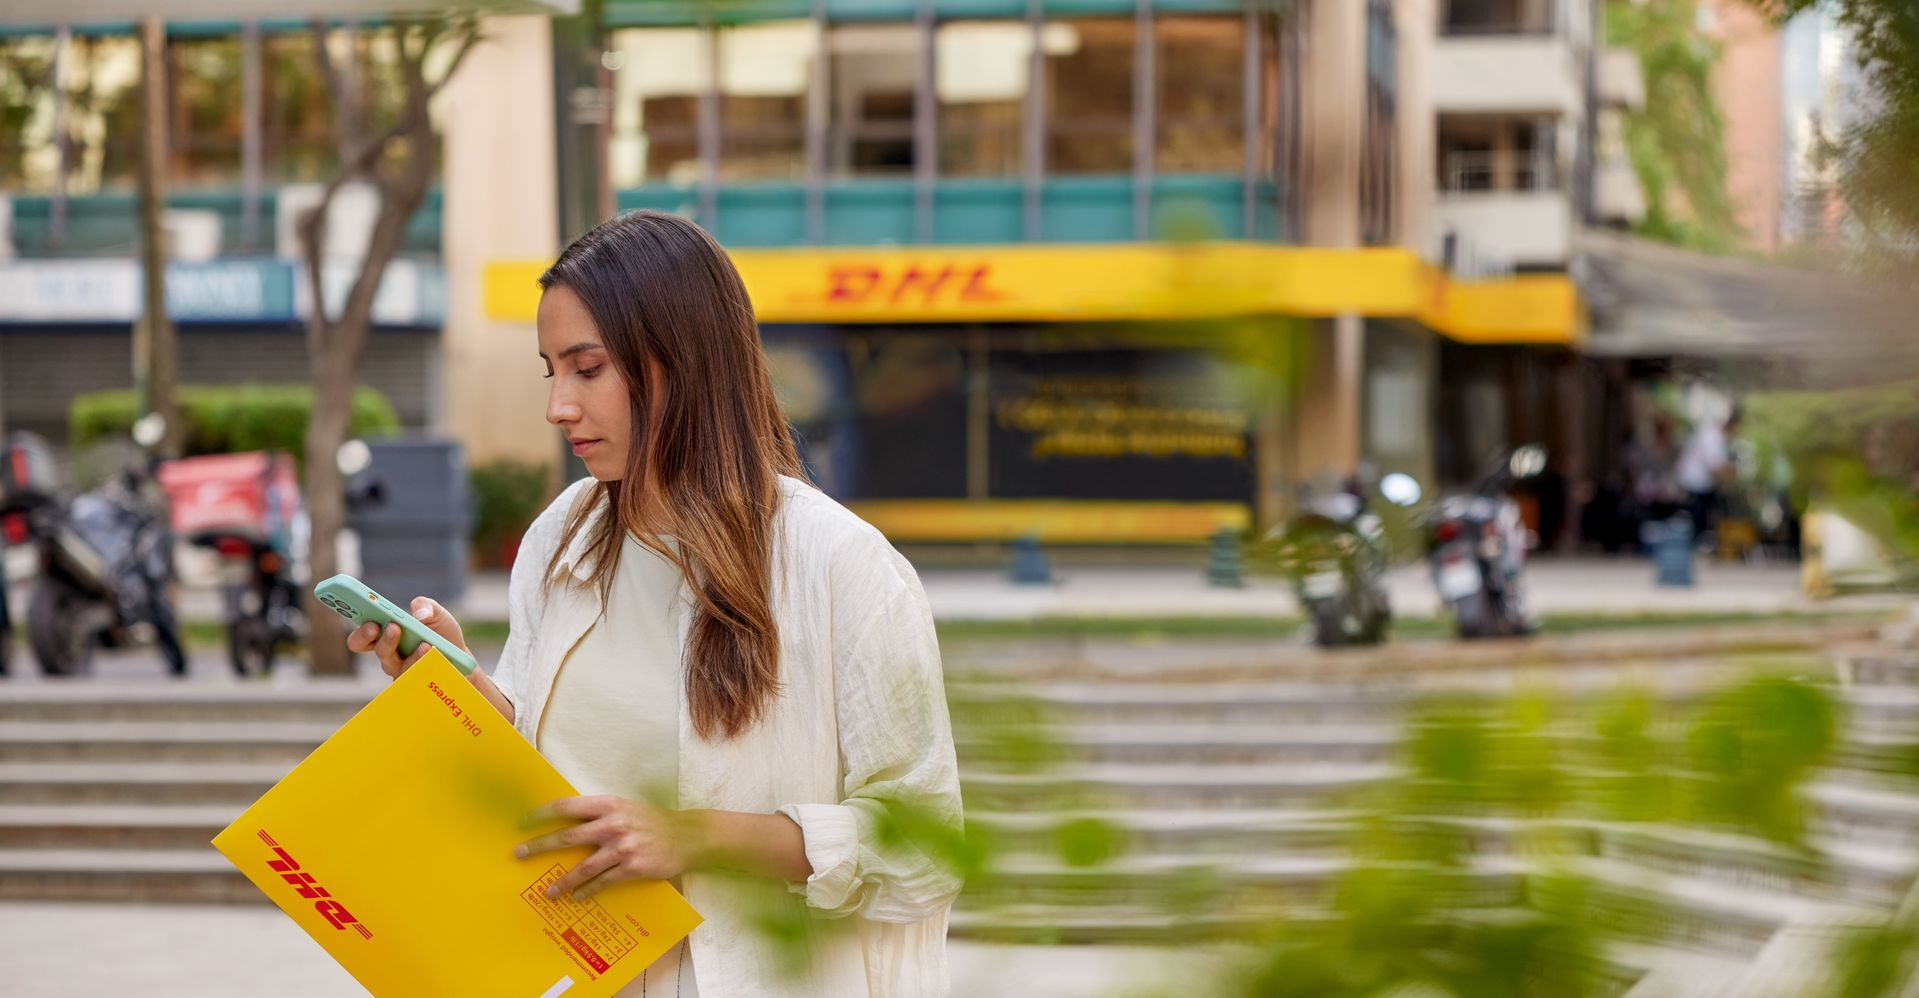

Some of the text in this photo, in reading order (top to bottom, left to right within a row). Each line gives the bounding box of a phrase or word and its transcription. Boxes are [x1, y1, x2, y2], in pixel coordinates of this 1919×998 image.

[826, 262, 1012, 304] DHL
[428, 681, 482, 737] DHL Express
[266, 847, 359, 931] DHL
[623, 912, 649, 938] dhl.com
[541, 926, 596, 981] Recommended weight
